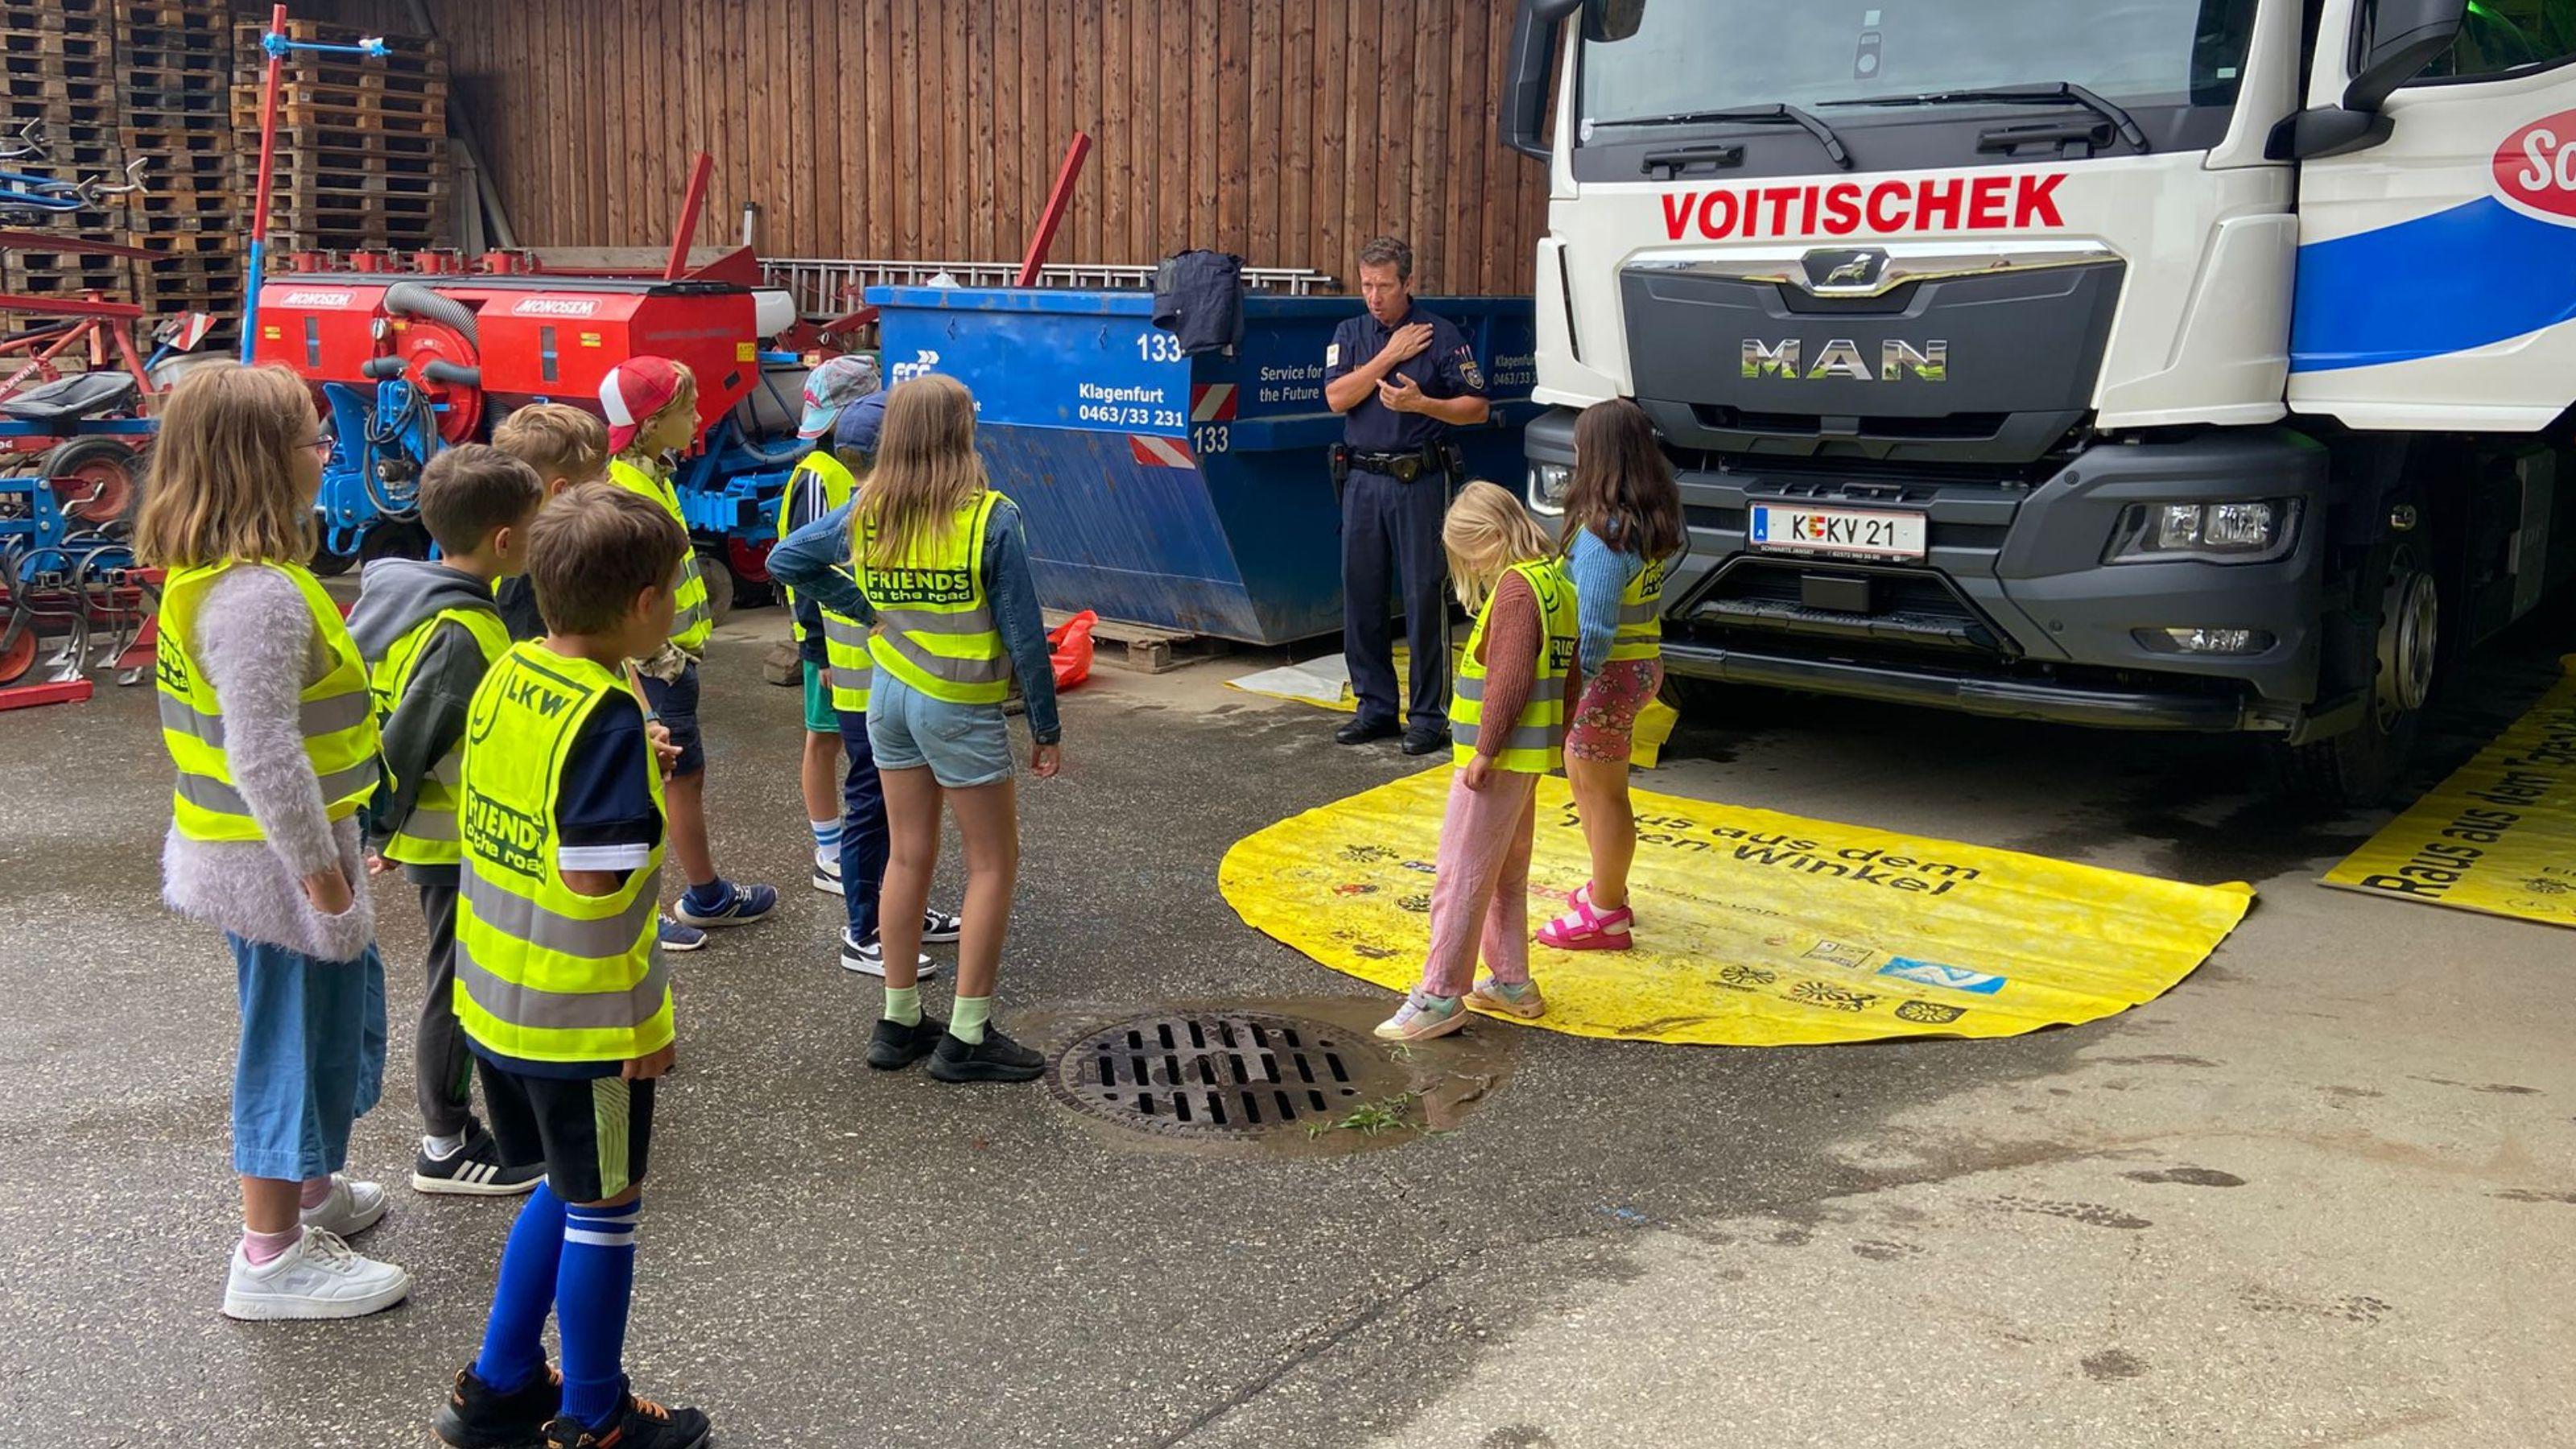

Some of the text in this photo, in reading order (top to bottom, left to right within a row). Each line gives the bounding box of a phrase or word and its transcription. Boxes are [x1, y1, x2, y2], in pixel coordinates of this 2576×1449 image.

[1661, 173, 2067, 241] VOITISCHEK
[283, 291, 353, 306] MONOSEM
[514, 299, 596, 316] MONOSEM
[1137, 332, 1182, 362] 133
[1740, 339, 1948, 382] MAN
[1261, 364, 1323, 382] Service for
[1079, 382, 1164, 403] Klagenfurt
[1259, 386, 1319, 402] the Future
[1079, 404, 1184, 427] 0463/33 231
[1193, 426, 1228, 453] 133
[1792, 514, 1893, 547] K KV 21
[867, 570, 969, 591] FRIENDS
[927, 589, 971, 603] road
[507, 675, 572, 719] LKW
[1711, 826, 1819, 852] aus
[1836, 844, 1981, 881] dem
[2359, 843, 2483, 898] Raus
[2440, 807, 2521, 844] aus
[1733, 844, 1956, 895] Winkel
